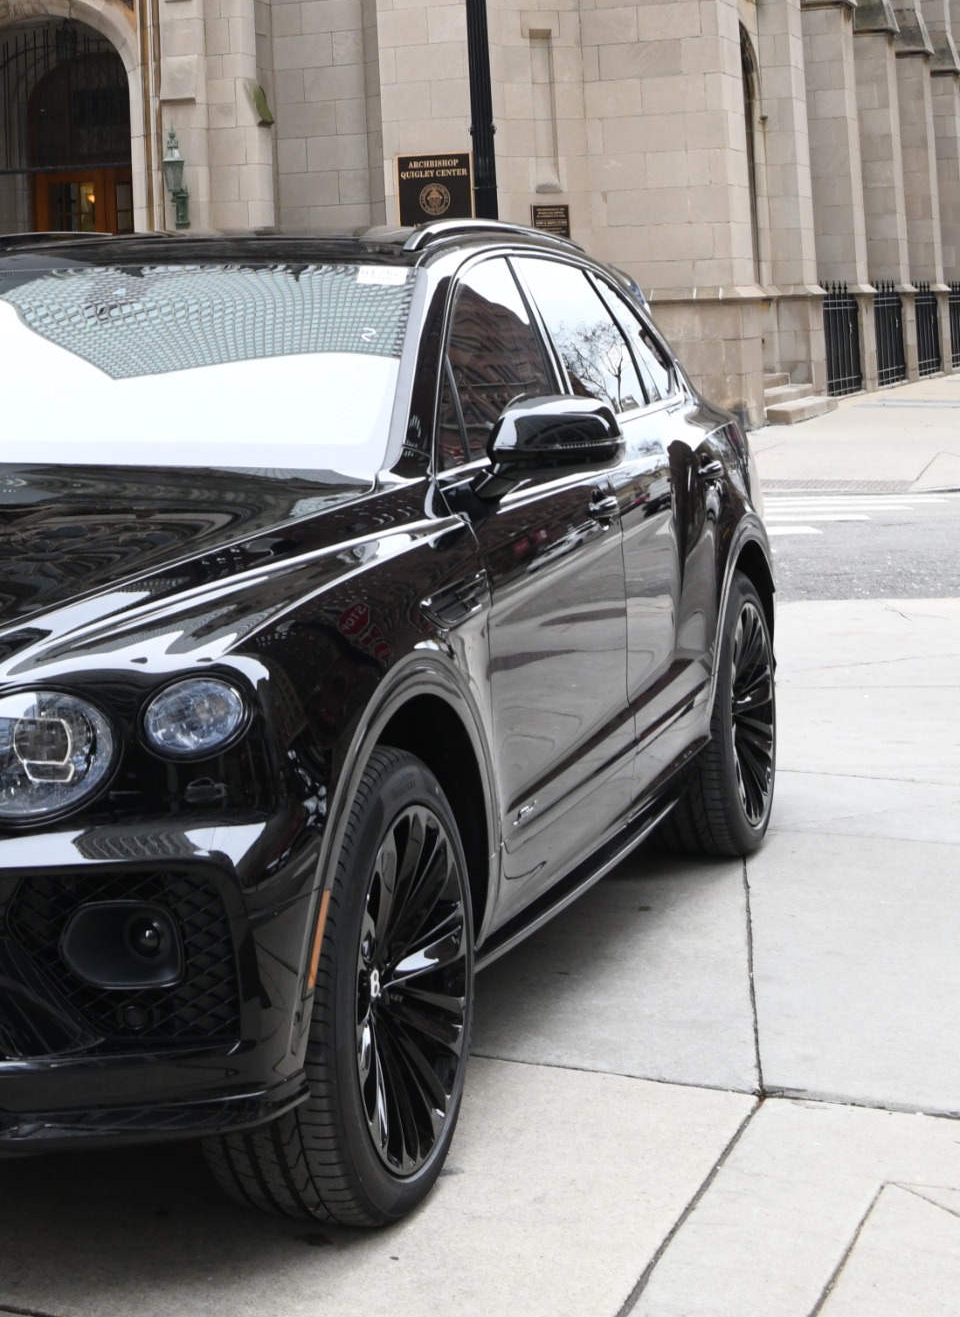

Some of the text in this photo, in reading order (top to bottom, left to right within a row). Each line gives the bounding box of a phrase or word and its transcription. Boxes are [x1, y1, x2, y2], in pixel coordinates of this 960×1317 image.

[408, 158, 459, 169] ARCHBISHOP
[400, 168, 468, 180] QUIGLEY CENTER
